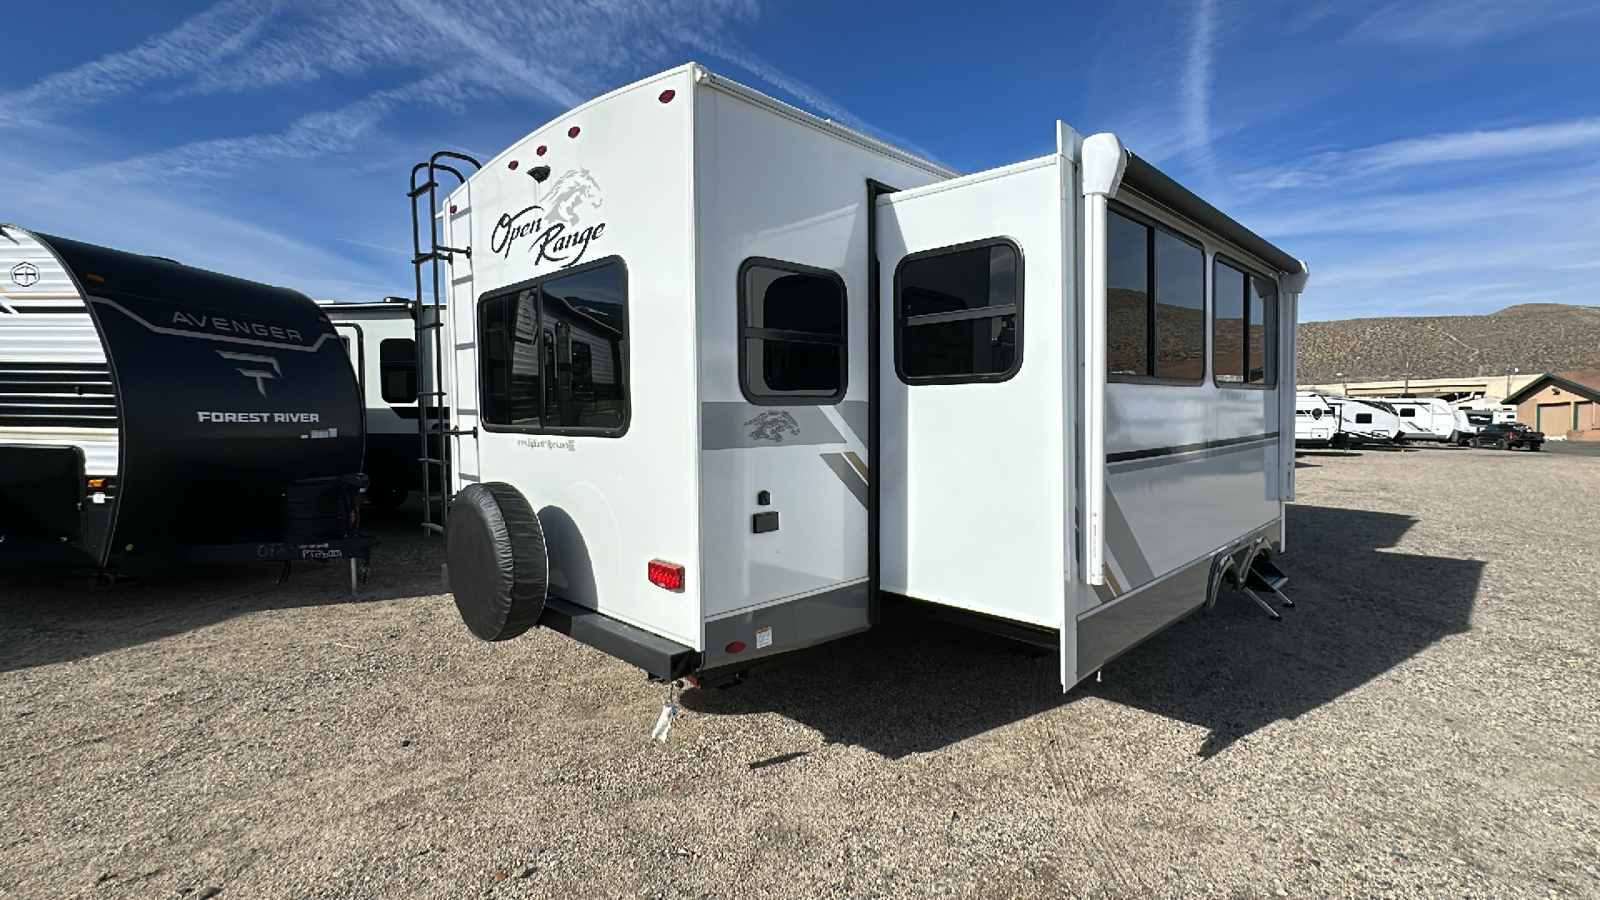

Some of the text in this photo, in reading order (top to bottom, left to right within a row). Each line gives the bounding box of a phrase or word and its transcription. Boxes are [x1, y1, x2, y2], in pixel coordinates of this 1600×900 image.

[491, 205, 545, 260] Open
[528, 222, 606, 268] Range
[172, 311, 303, 342] AVENGER
[196, 411, 320, 423] FOREST RIVER
